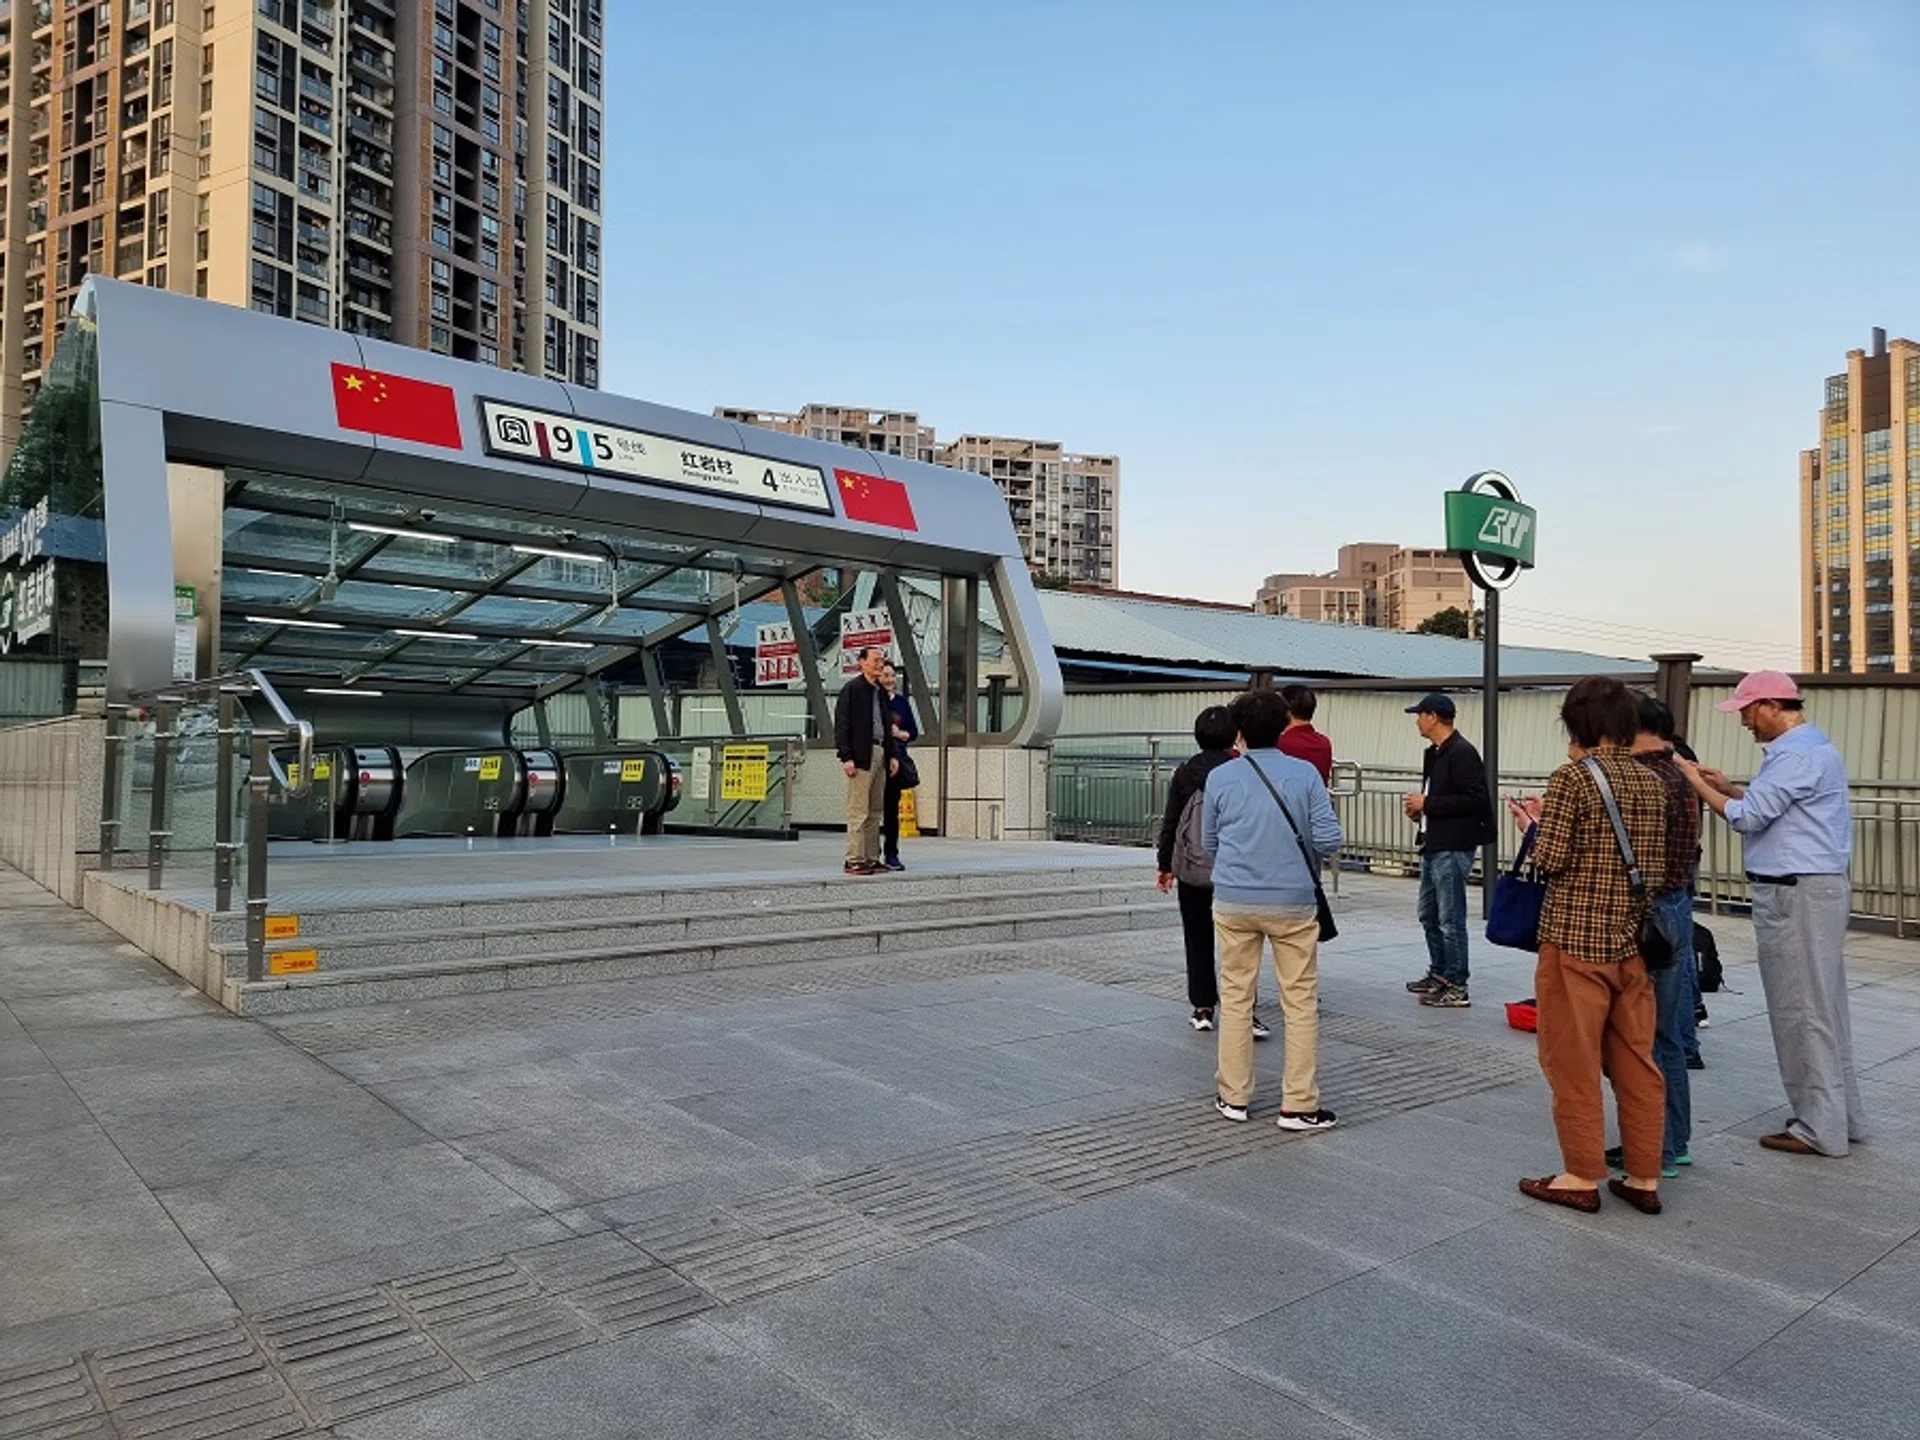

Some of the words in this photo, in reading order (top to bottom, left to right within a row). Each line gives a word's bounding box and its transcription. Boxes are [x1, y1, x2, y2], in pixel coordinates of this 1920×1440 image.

[553, 426, 573, 453] 9
[593, 433, 613, 460] 5
[680, 450, 733, 475] 红岩村
[762, 467, 778, 491] 4
[779, 471, 819, 489] 出入口
